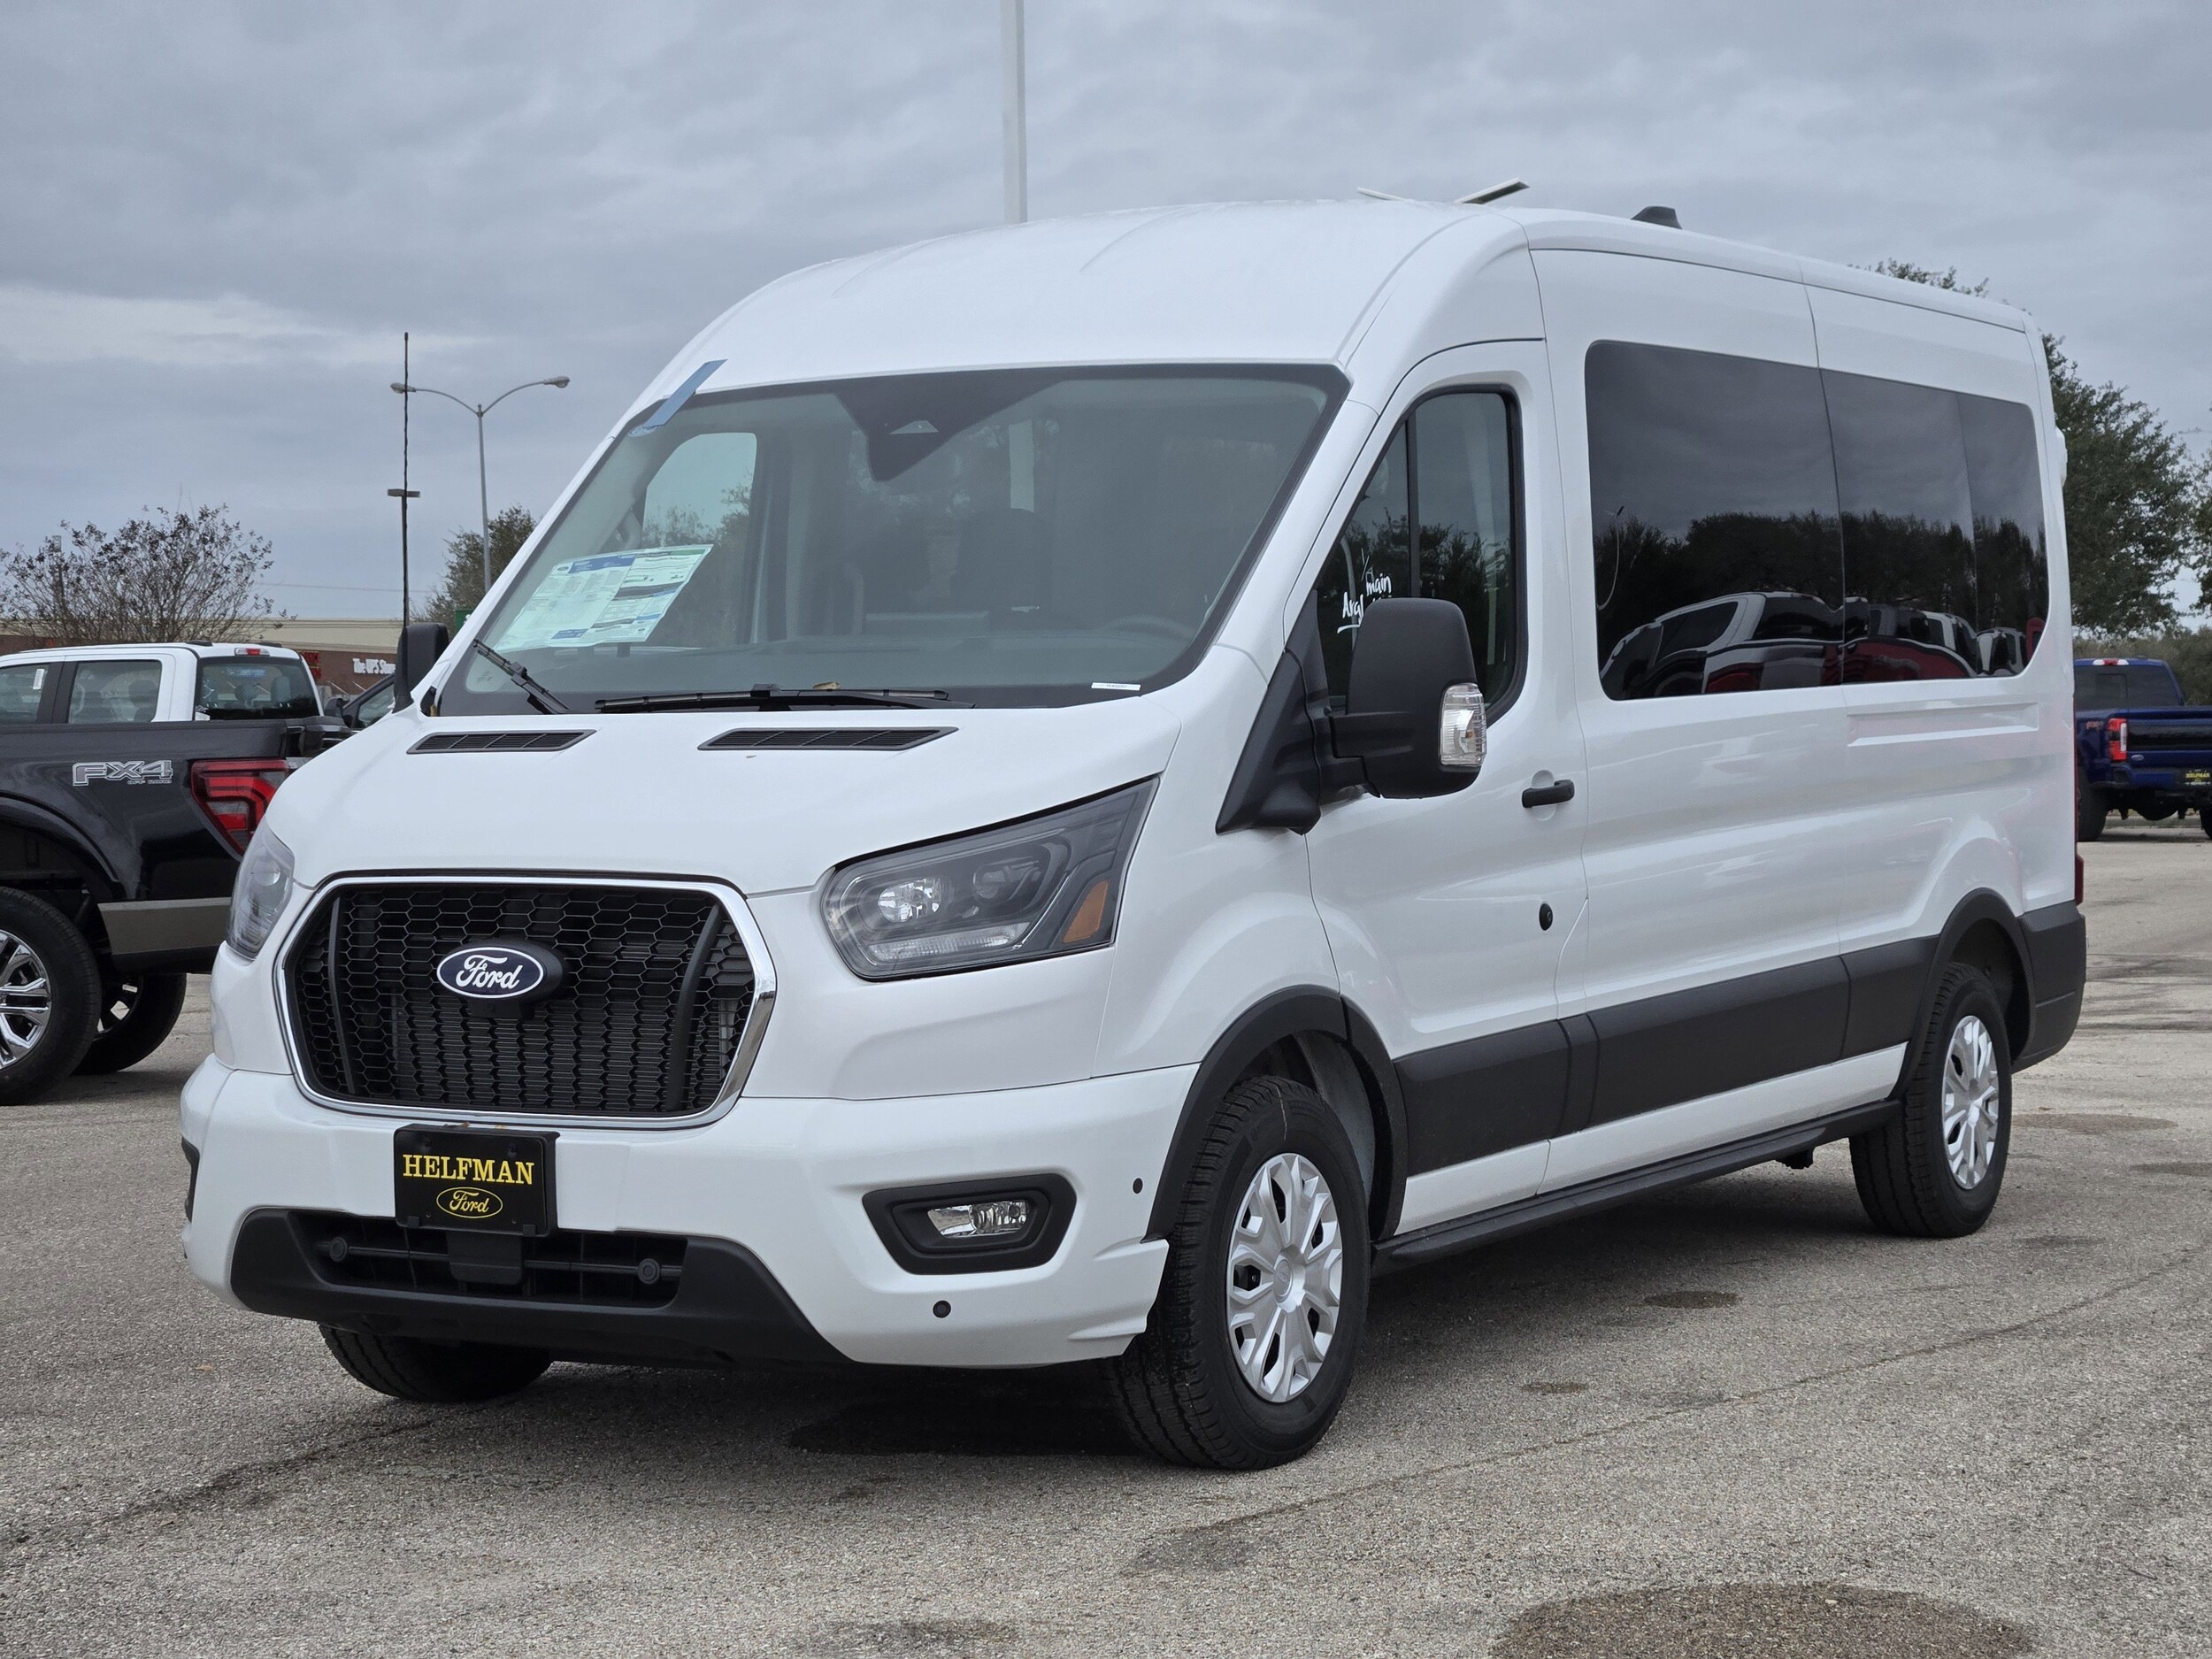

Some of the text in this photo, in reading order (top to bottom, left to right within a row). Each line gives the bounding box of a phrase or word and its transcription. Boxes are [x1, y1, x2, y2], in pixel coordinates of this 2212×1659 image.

[352, 657, 365, 673] The
[365, 658, 379, 673] UPS
[73, 760, 173, 787] FX4
[455, 954, 523, 989] Ford
[403, 1154, 535, 1185] HELFMAN
[449, 1189, 489, 1213] Ford
